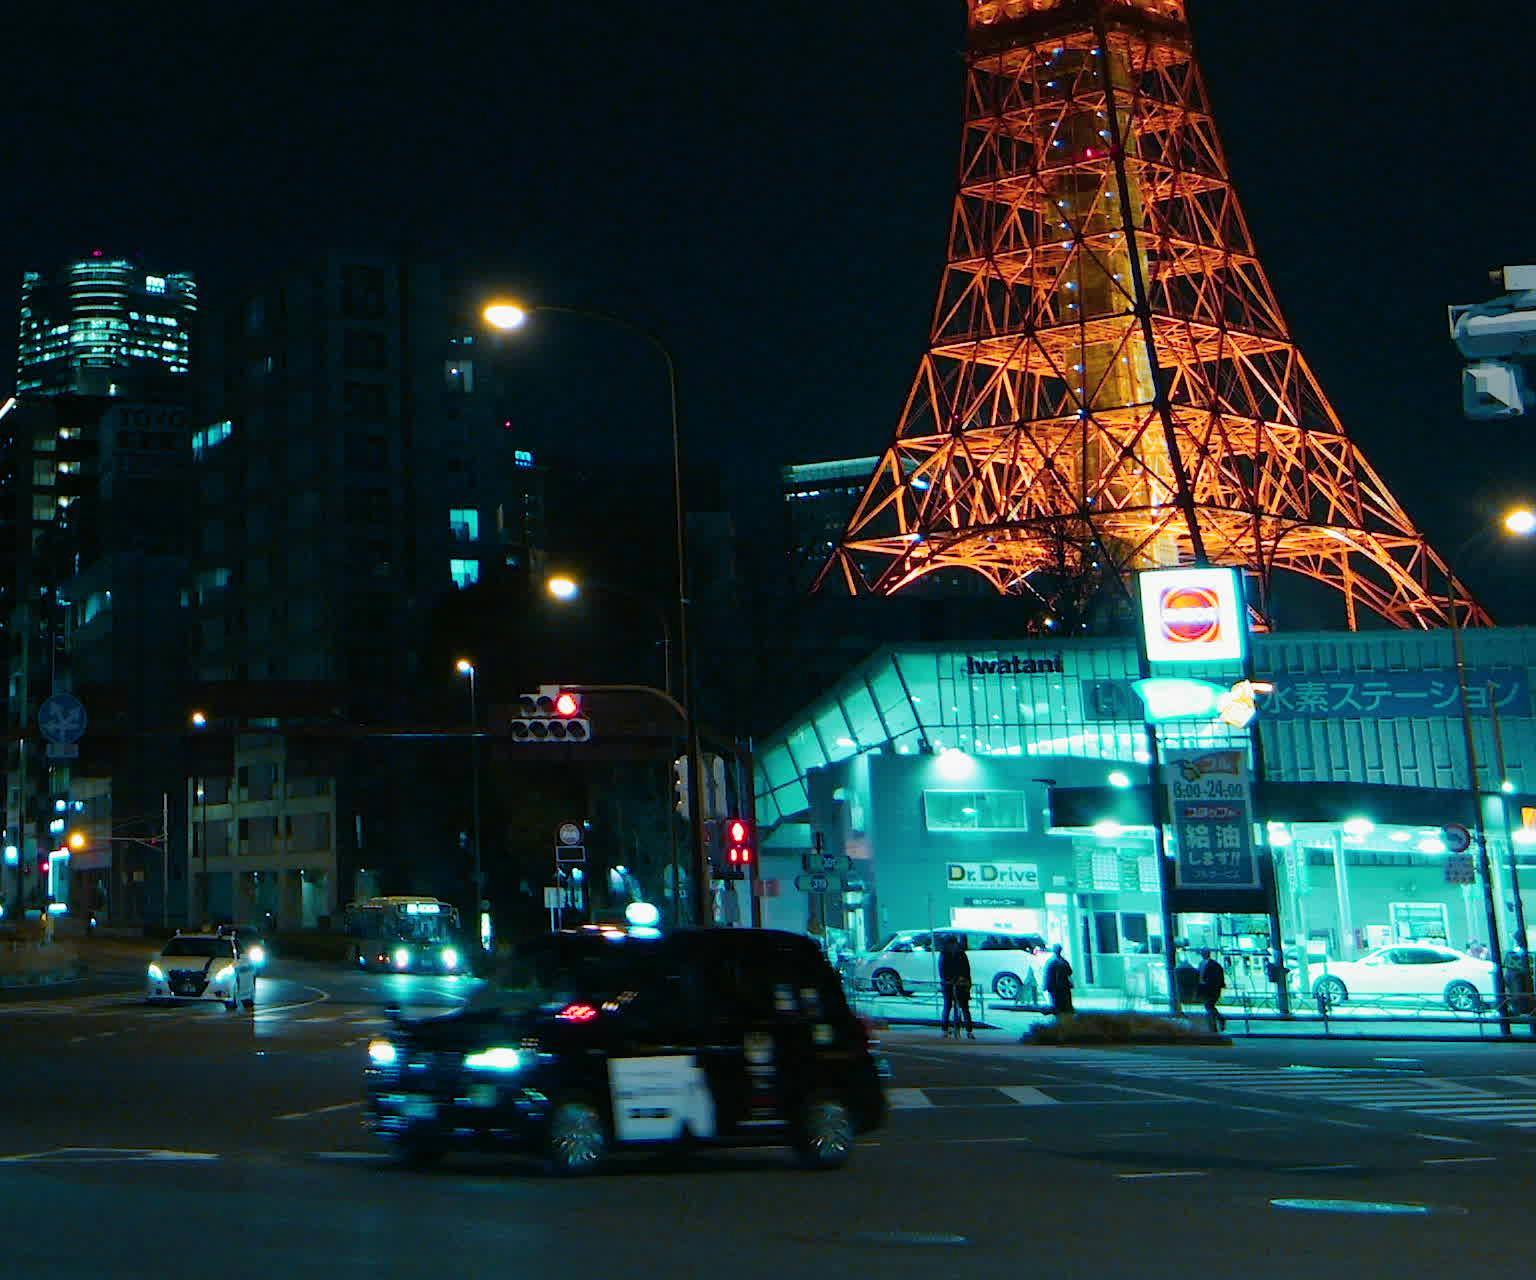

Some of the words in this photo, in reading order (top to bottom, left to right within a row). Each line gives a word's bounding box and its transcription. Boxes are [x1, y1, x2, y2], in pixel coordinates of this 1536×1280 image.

[967, 654, 1063, 675] Iwatani
[1260, 680, 1520, 713] 水素ステーション
[948, 864, 977, 882] Dr.
[980, 864, 1038, 883] Drive
